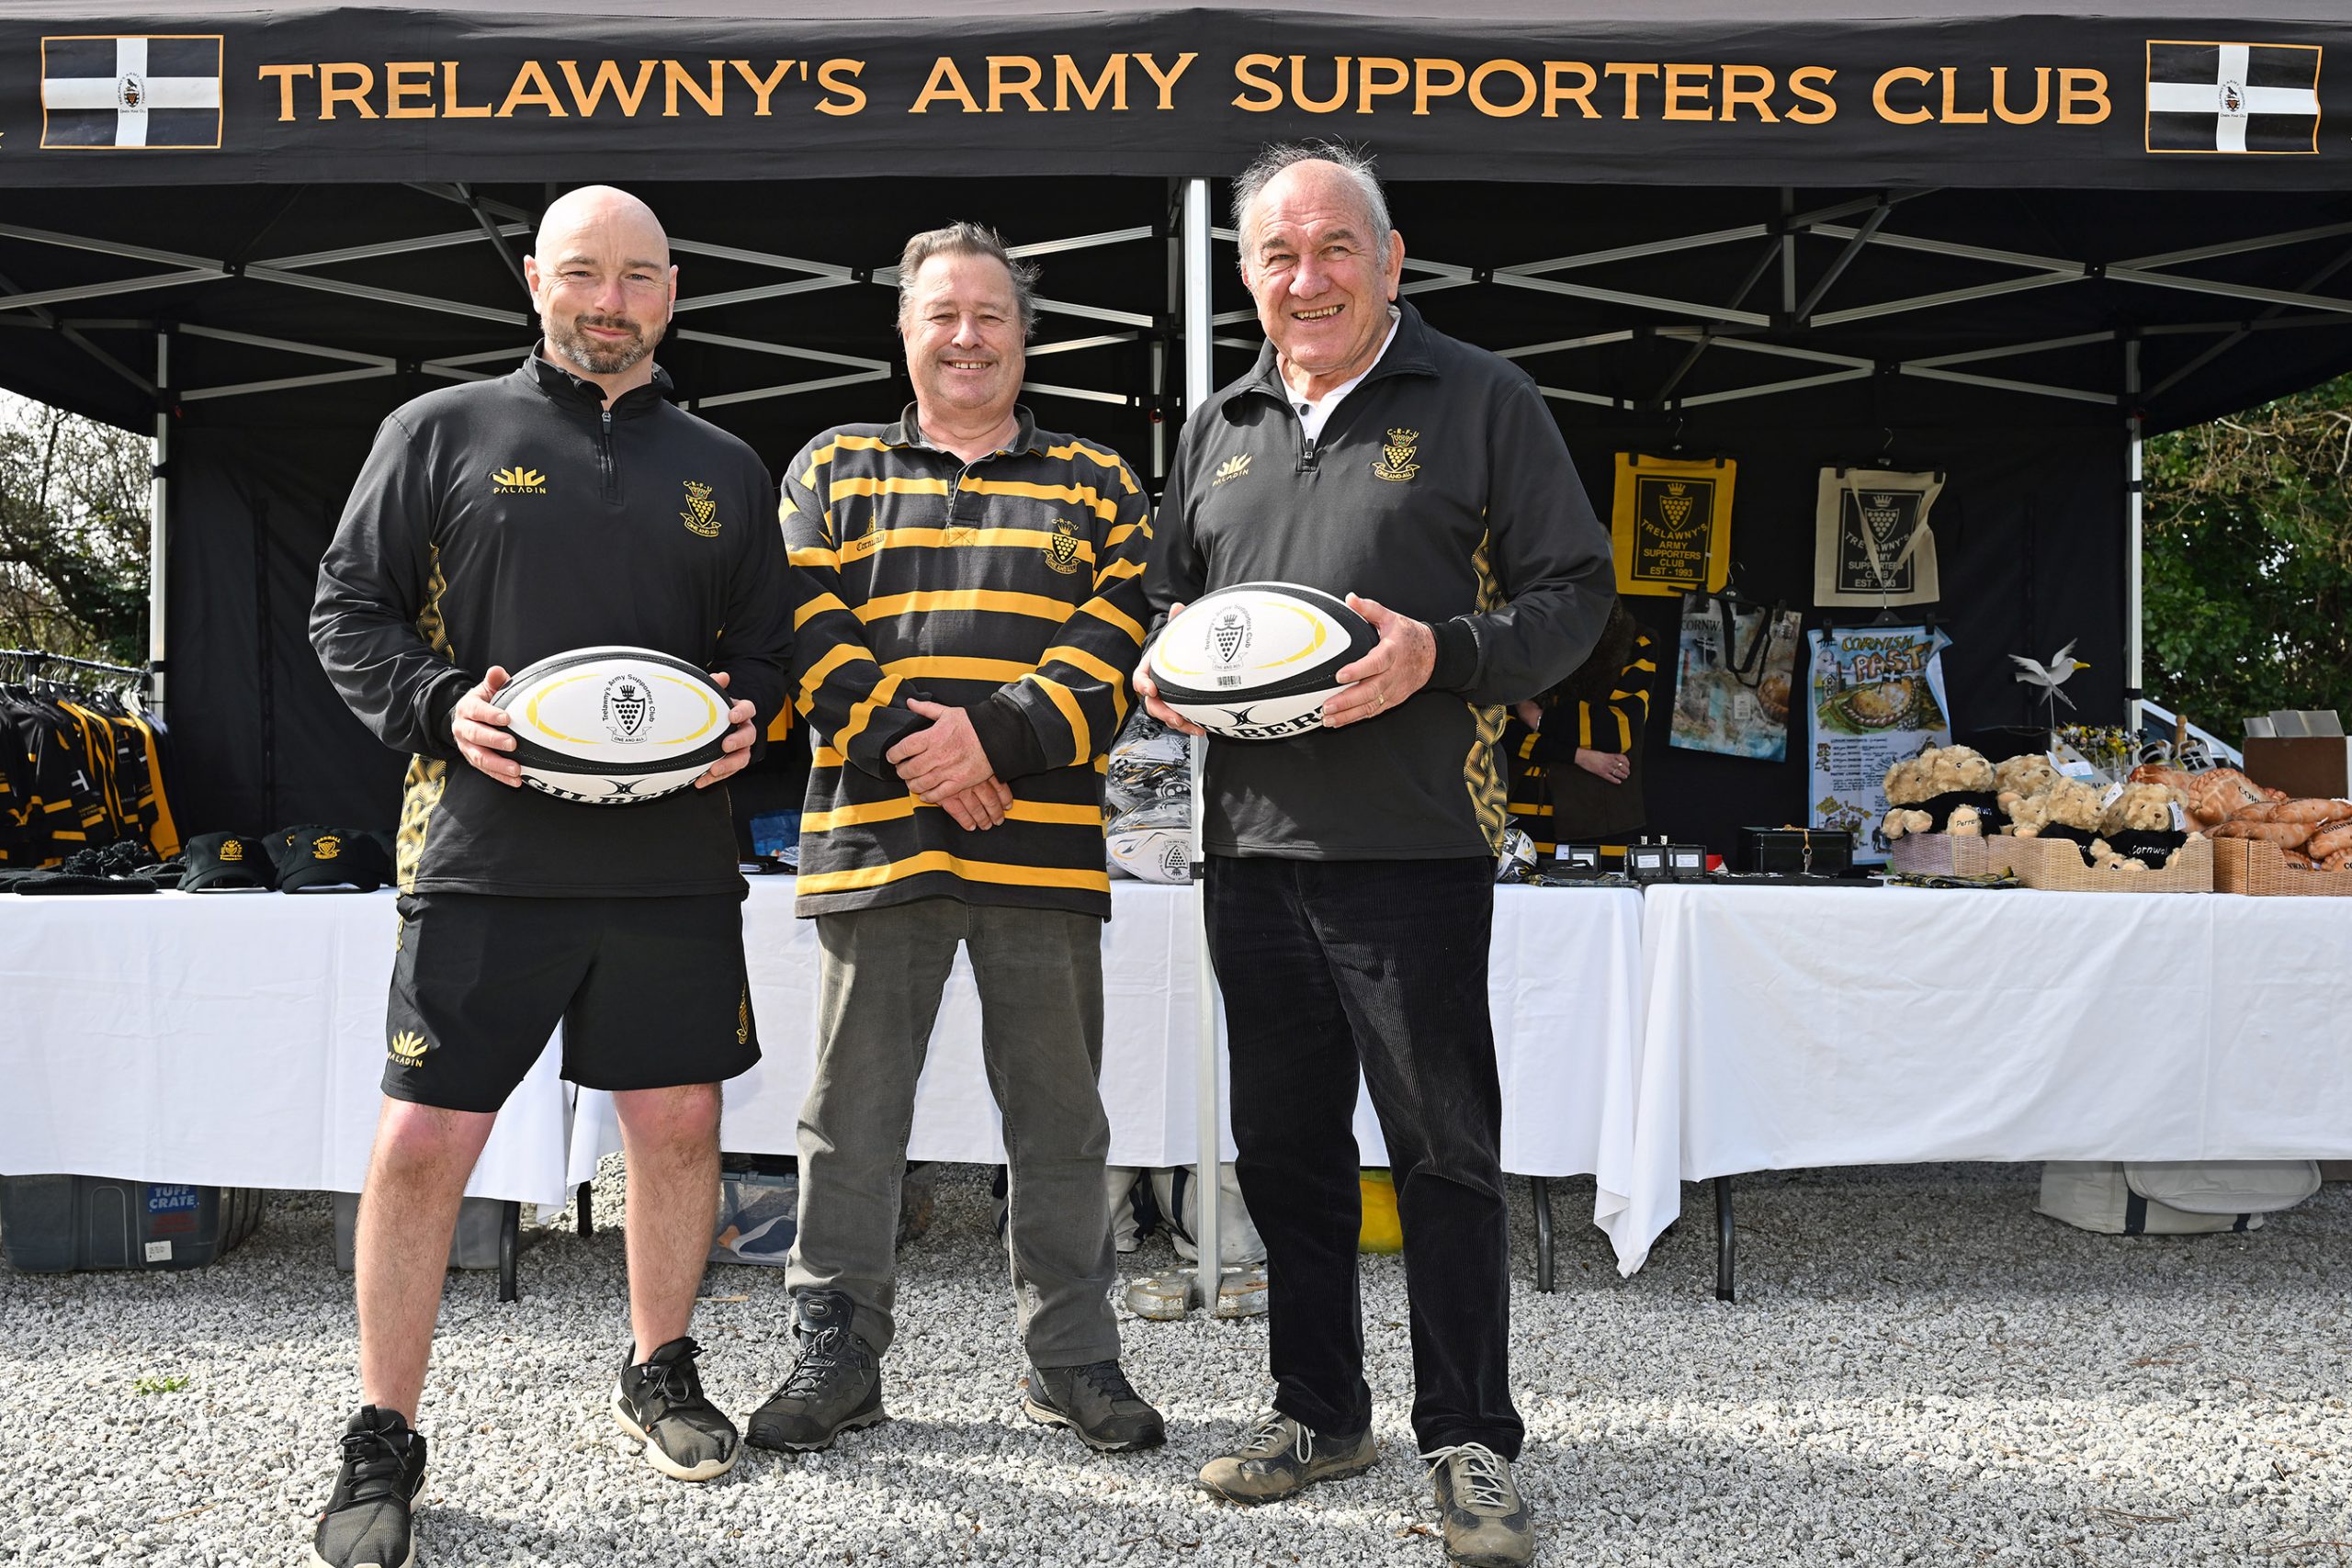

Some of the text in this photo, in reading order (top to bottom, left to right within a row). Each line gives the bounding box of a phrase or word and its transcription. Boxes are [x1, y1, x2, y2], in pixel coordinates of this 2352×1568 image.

[258, 52, 2111, 126] TRELAWNY'S ARMY SUPPORTERS CLUB
[492, 486, 547, 494] PALADIN
[1641, 518, 1708, 540] TRELAWNY'S
[1659, 540, 1689, 550] ARMY
[1643, 547, 1702, 560] SUPPORTERS
[1659, 558, 1685, 568] CLUB
[1649, 566, 1667, 575] EST
[1675, 568, 1693, 577] 1993
[1854, 579, 1872, 588] EST
[1245, 632, 1253, 649] Club
[1841, 634, 1915, 652] CORNISH
[602, 686, 612, 722] Trelawny's
[607, 674, 626, 686] Army
[627, 673, 653, 705] Supporters
[154, 1185, 190, 1198] TUFF
[149, 1194, 196, 1210] CRATE
